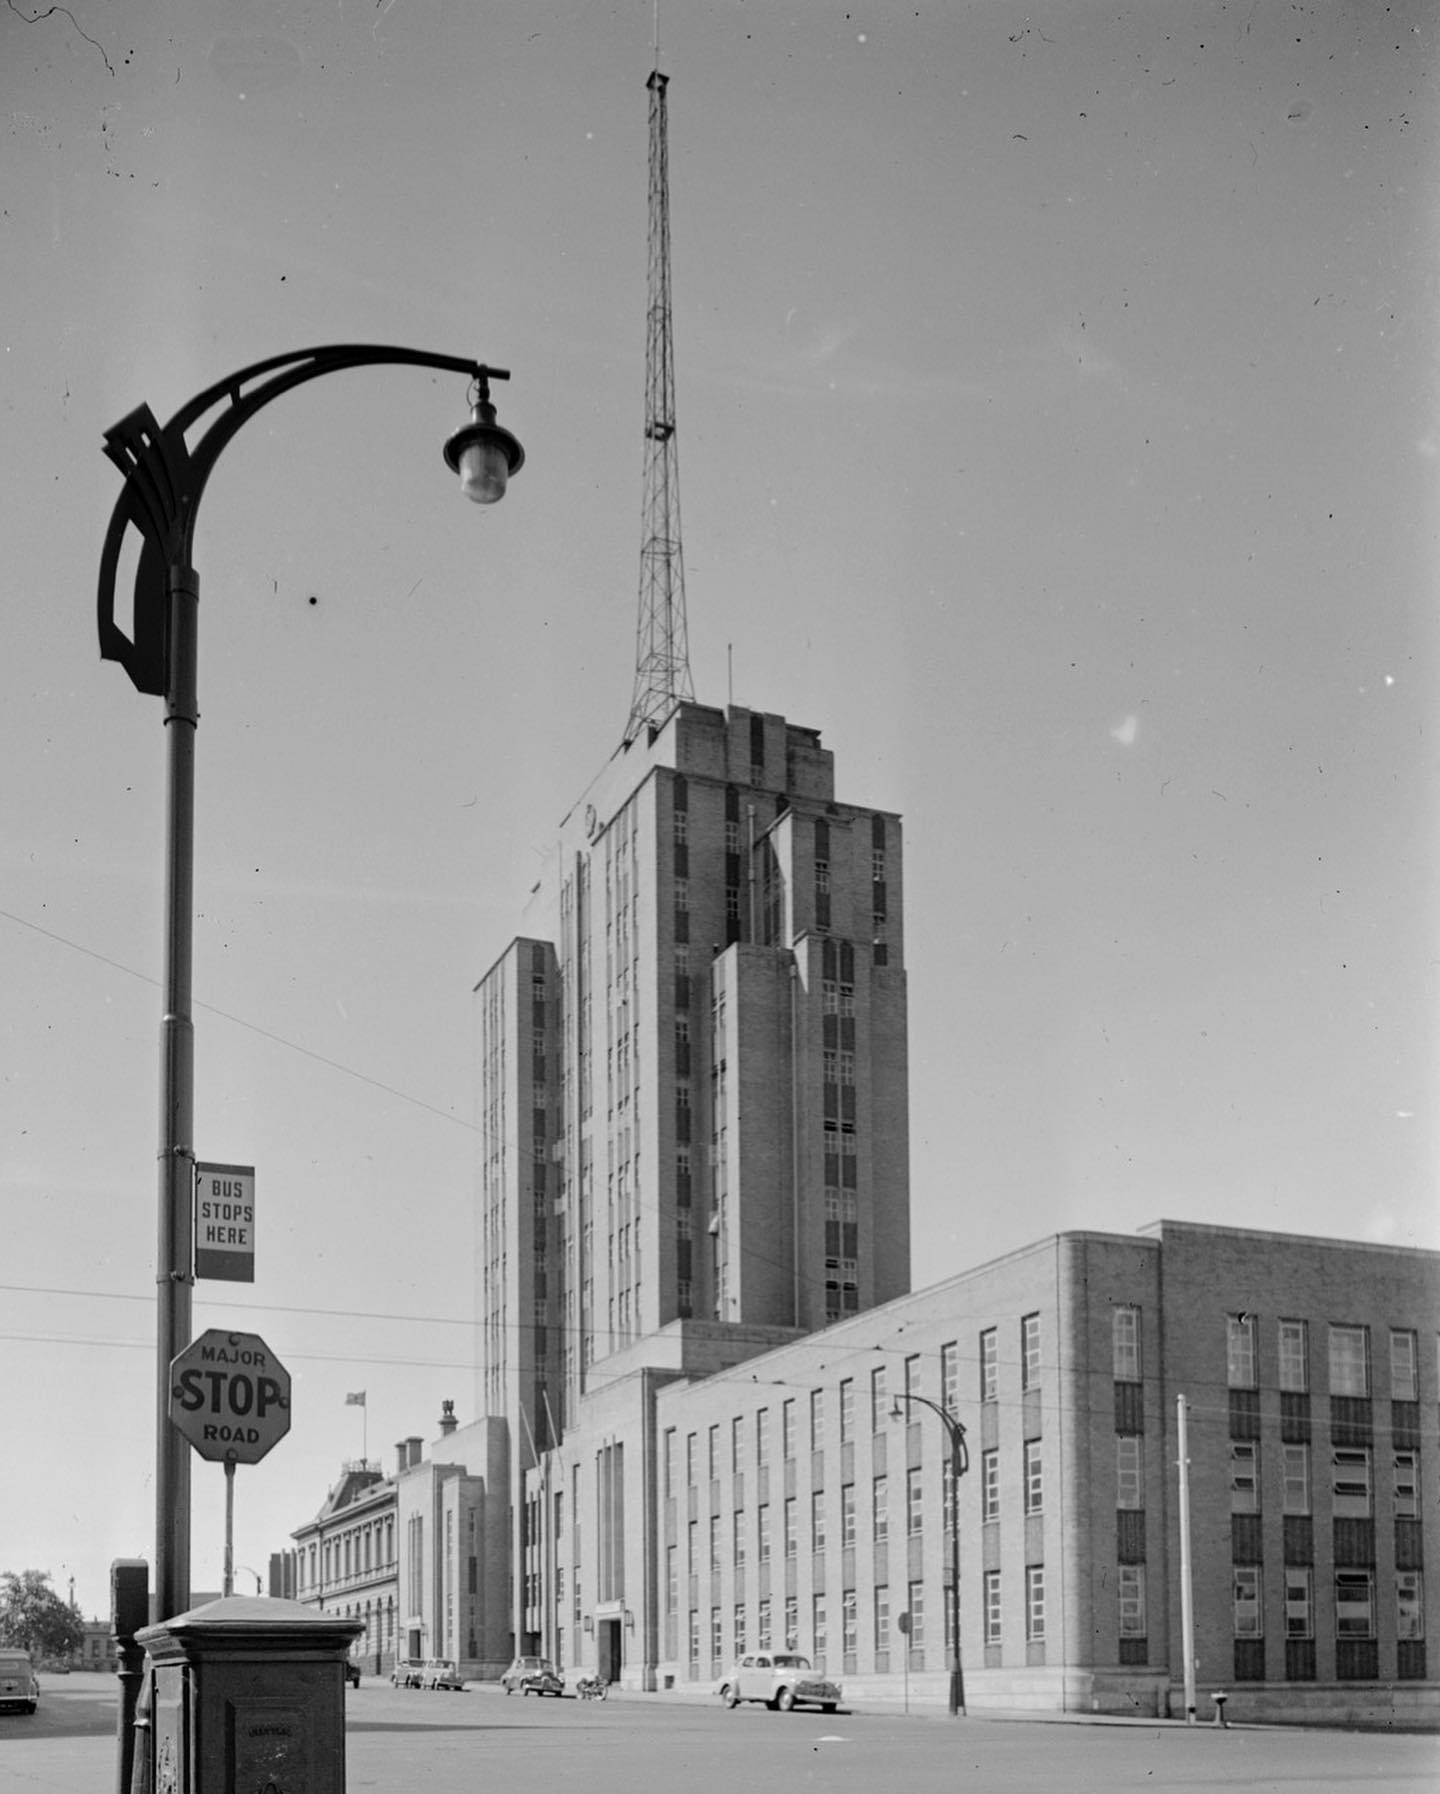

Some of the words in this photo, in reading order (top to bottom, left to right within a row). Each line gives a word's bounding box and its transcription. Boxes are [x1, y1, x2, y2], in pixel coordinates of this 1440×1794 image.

[212, 1180, 242, 1198] BUS
[202, 1202, 253, 1222] STOPS
[207, 1226, 247, 1245] HERE
[201, 1346, 265, 1366] MAJOR
[180, 1369, 281, 1417] STOP
[203, 1424, 260, 1443] ROAD
